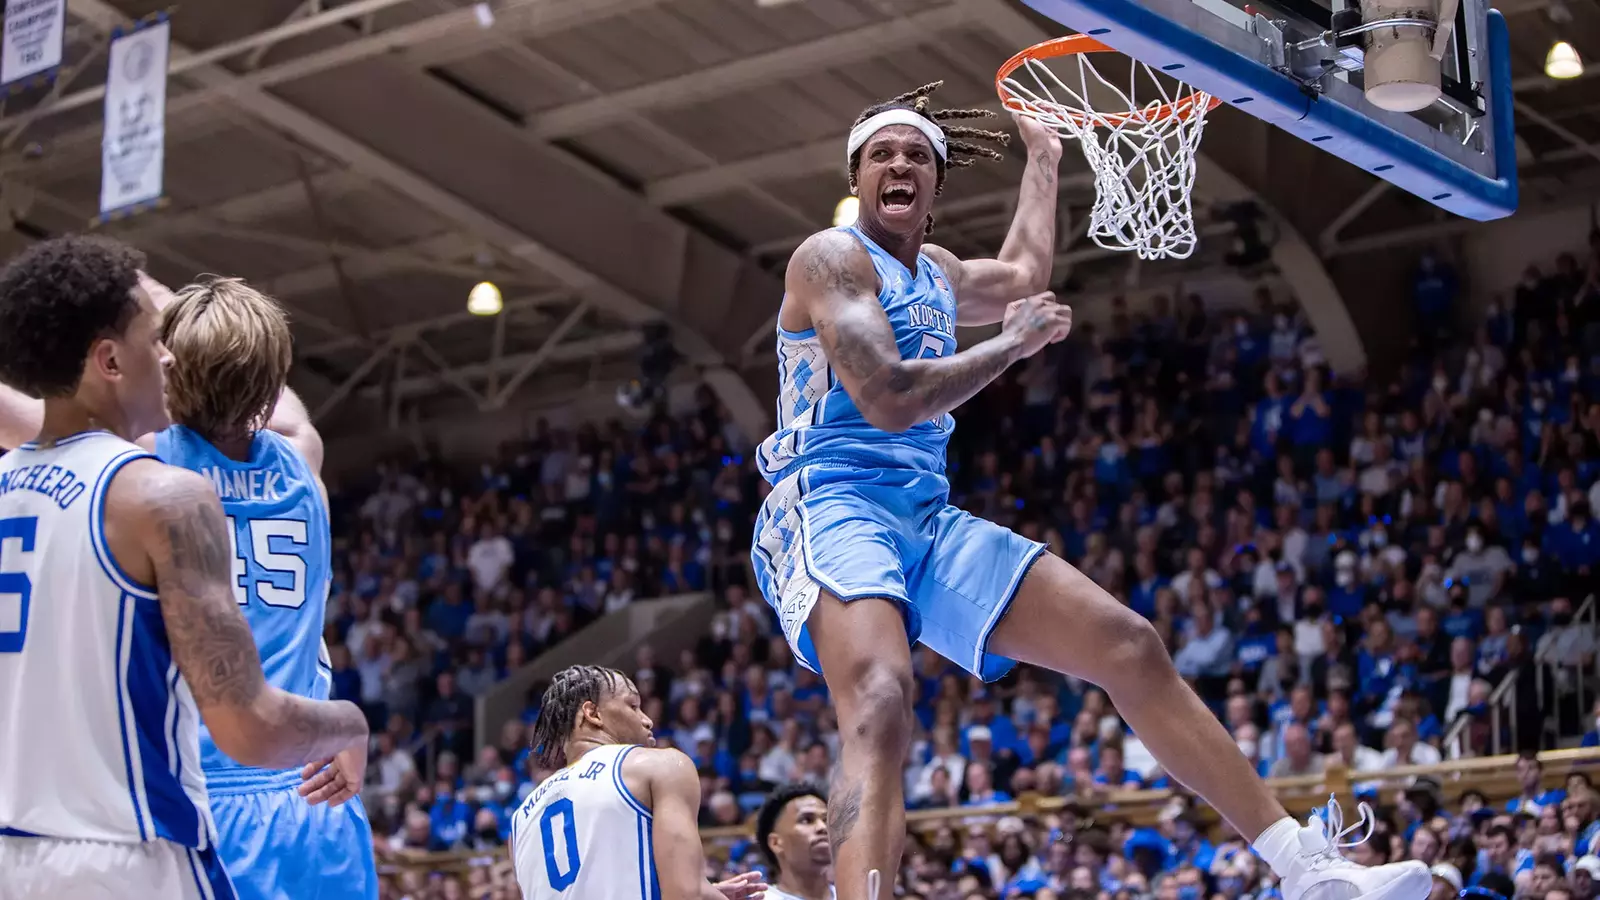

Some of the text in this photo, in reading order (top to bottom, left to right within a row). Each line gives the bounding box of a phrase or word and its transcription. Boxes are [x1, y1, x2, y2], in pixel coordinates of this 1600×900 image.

[907, 303, 953, 335] NORTH
[201, 465, 282, 501] MANEK
[578, 760, 606, 781] JR
[540, 797, 581, 892] 0
